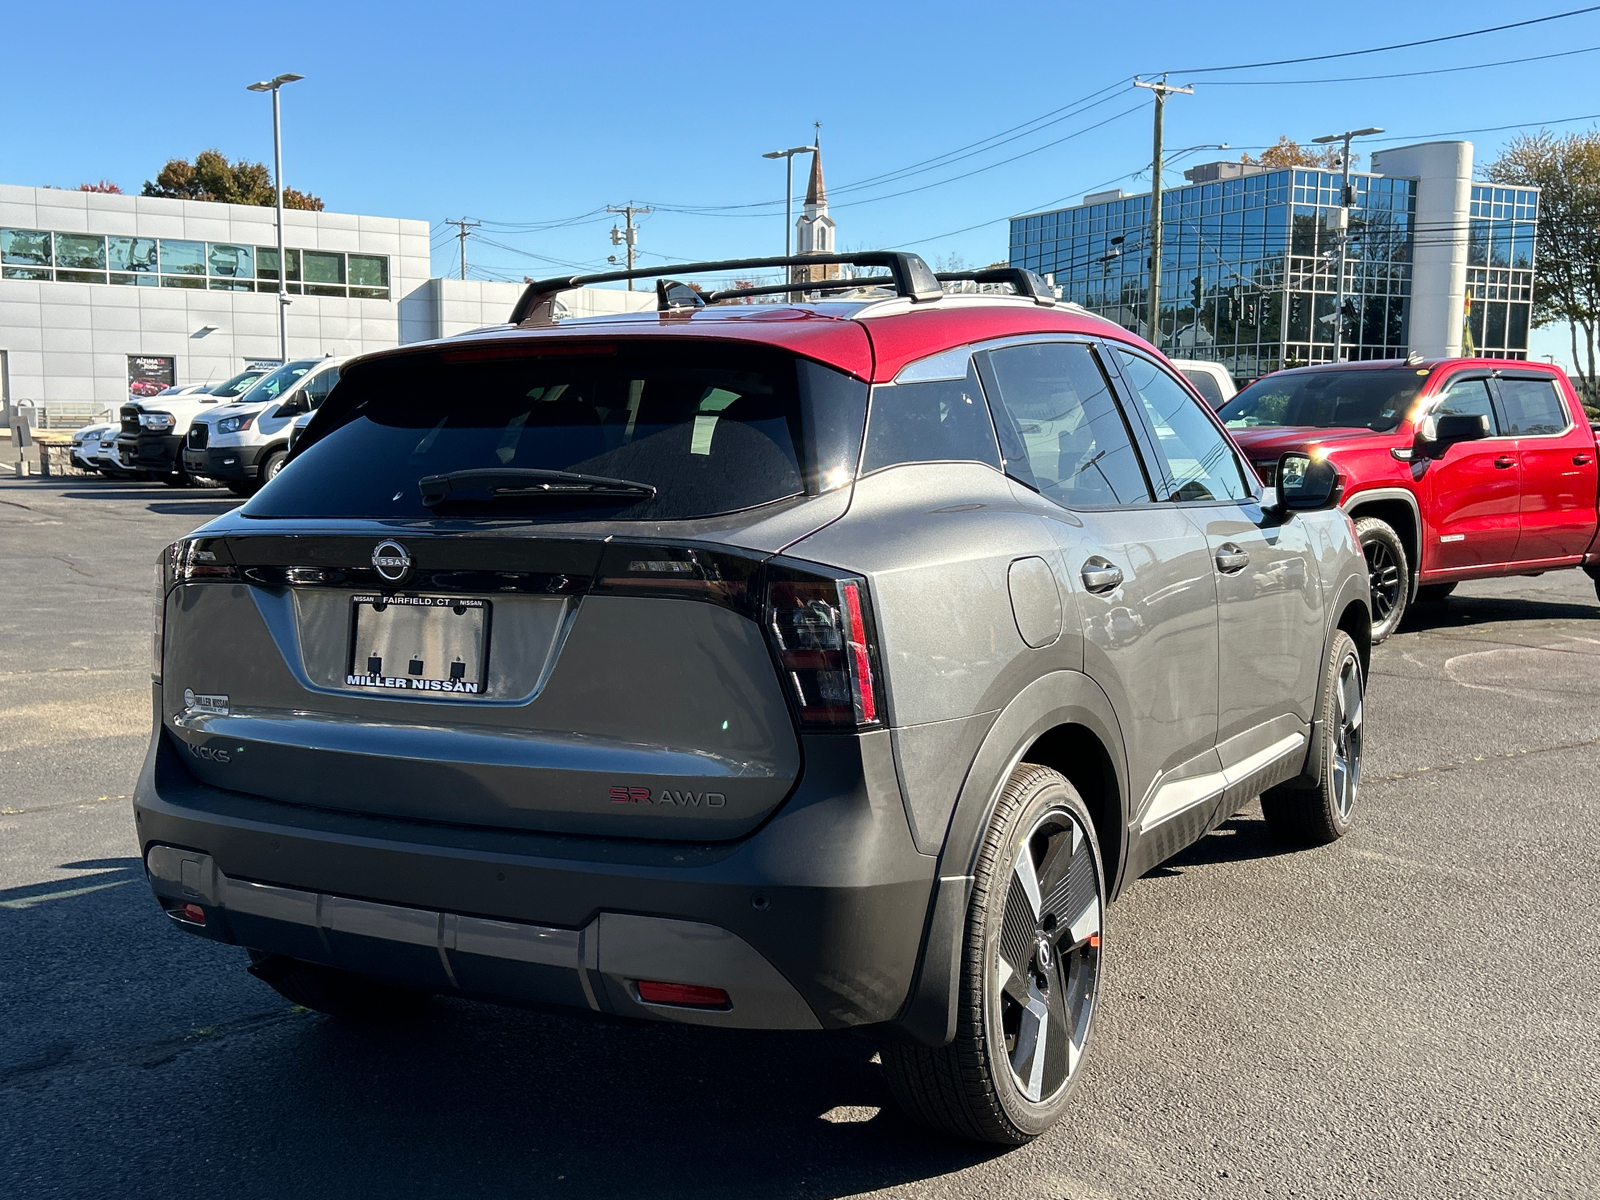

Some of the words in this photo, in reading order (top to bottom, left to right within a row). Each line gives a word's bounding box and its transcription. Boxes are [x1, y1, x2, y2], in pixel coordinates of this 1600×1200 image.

[373, 558, 410, 566] NISSAN
[383, 597, 434, 606] FAIRFIELD,
[436, 598, 451, 606] CT
[347, 675, 408, 689] MILLER
[411, 679, 479, 693] NISSAN
[194, 696, 211, 706] MILLER
[212, 699, 229, 709] NISSAN
[188, 743, 232, 763] KICKS
[609, 787, 653, 804] SR
[659, 790, 727, 808] AWD
